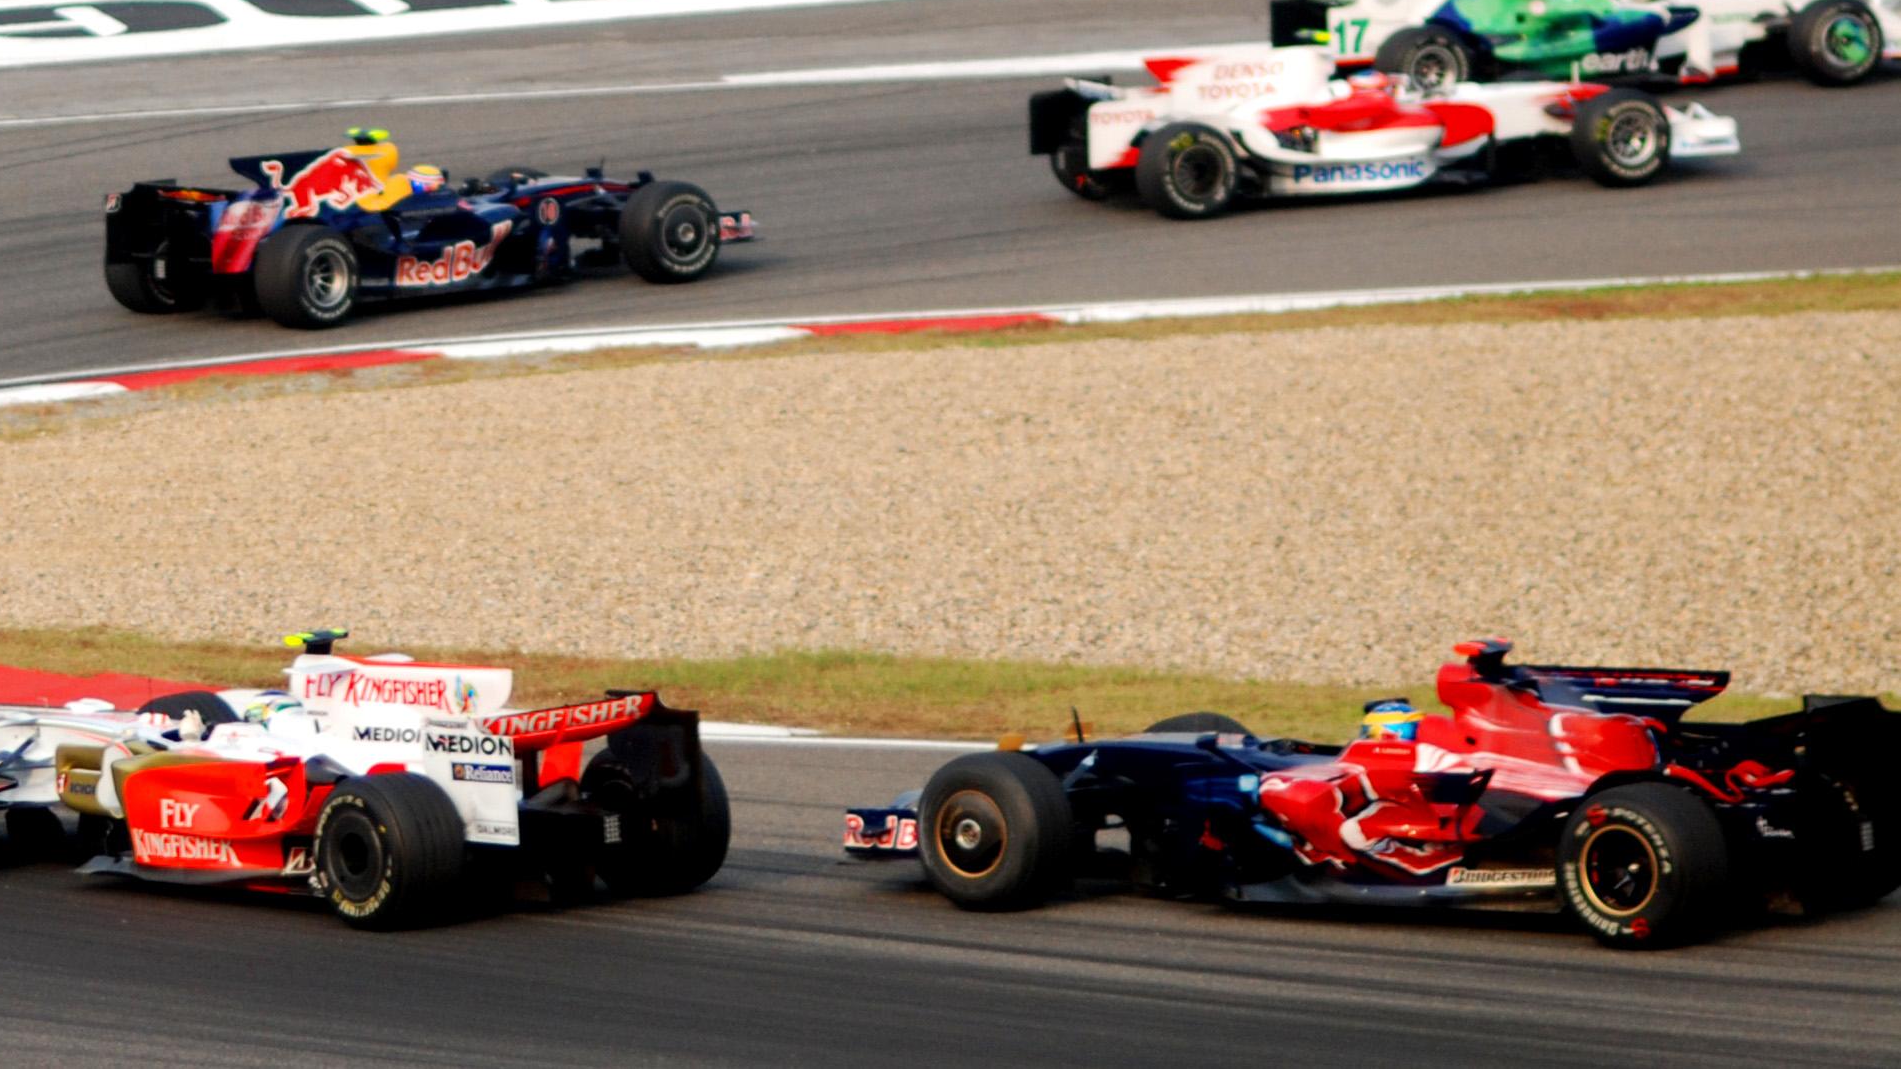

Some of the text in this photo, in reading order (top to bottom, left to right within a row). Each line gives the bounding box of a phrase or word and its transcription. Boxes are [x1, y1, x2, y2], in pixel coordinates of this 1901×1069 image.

[1335, 19, 1370, 54] 17
[1293, 159, 1426, 184] Panasonic
[345, 672, 454, 715] KINGFISHER
[425, 733, 513, 757] MEDION
[160, 798, 201, 829] FLY
[132, 828, 243, 868] KINGFISHER
